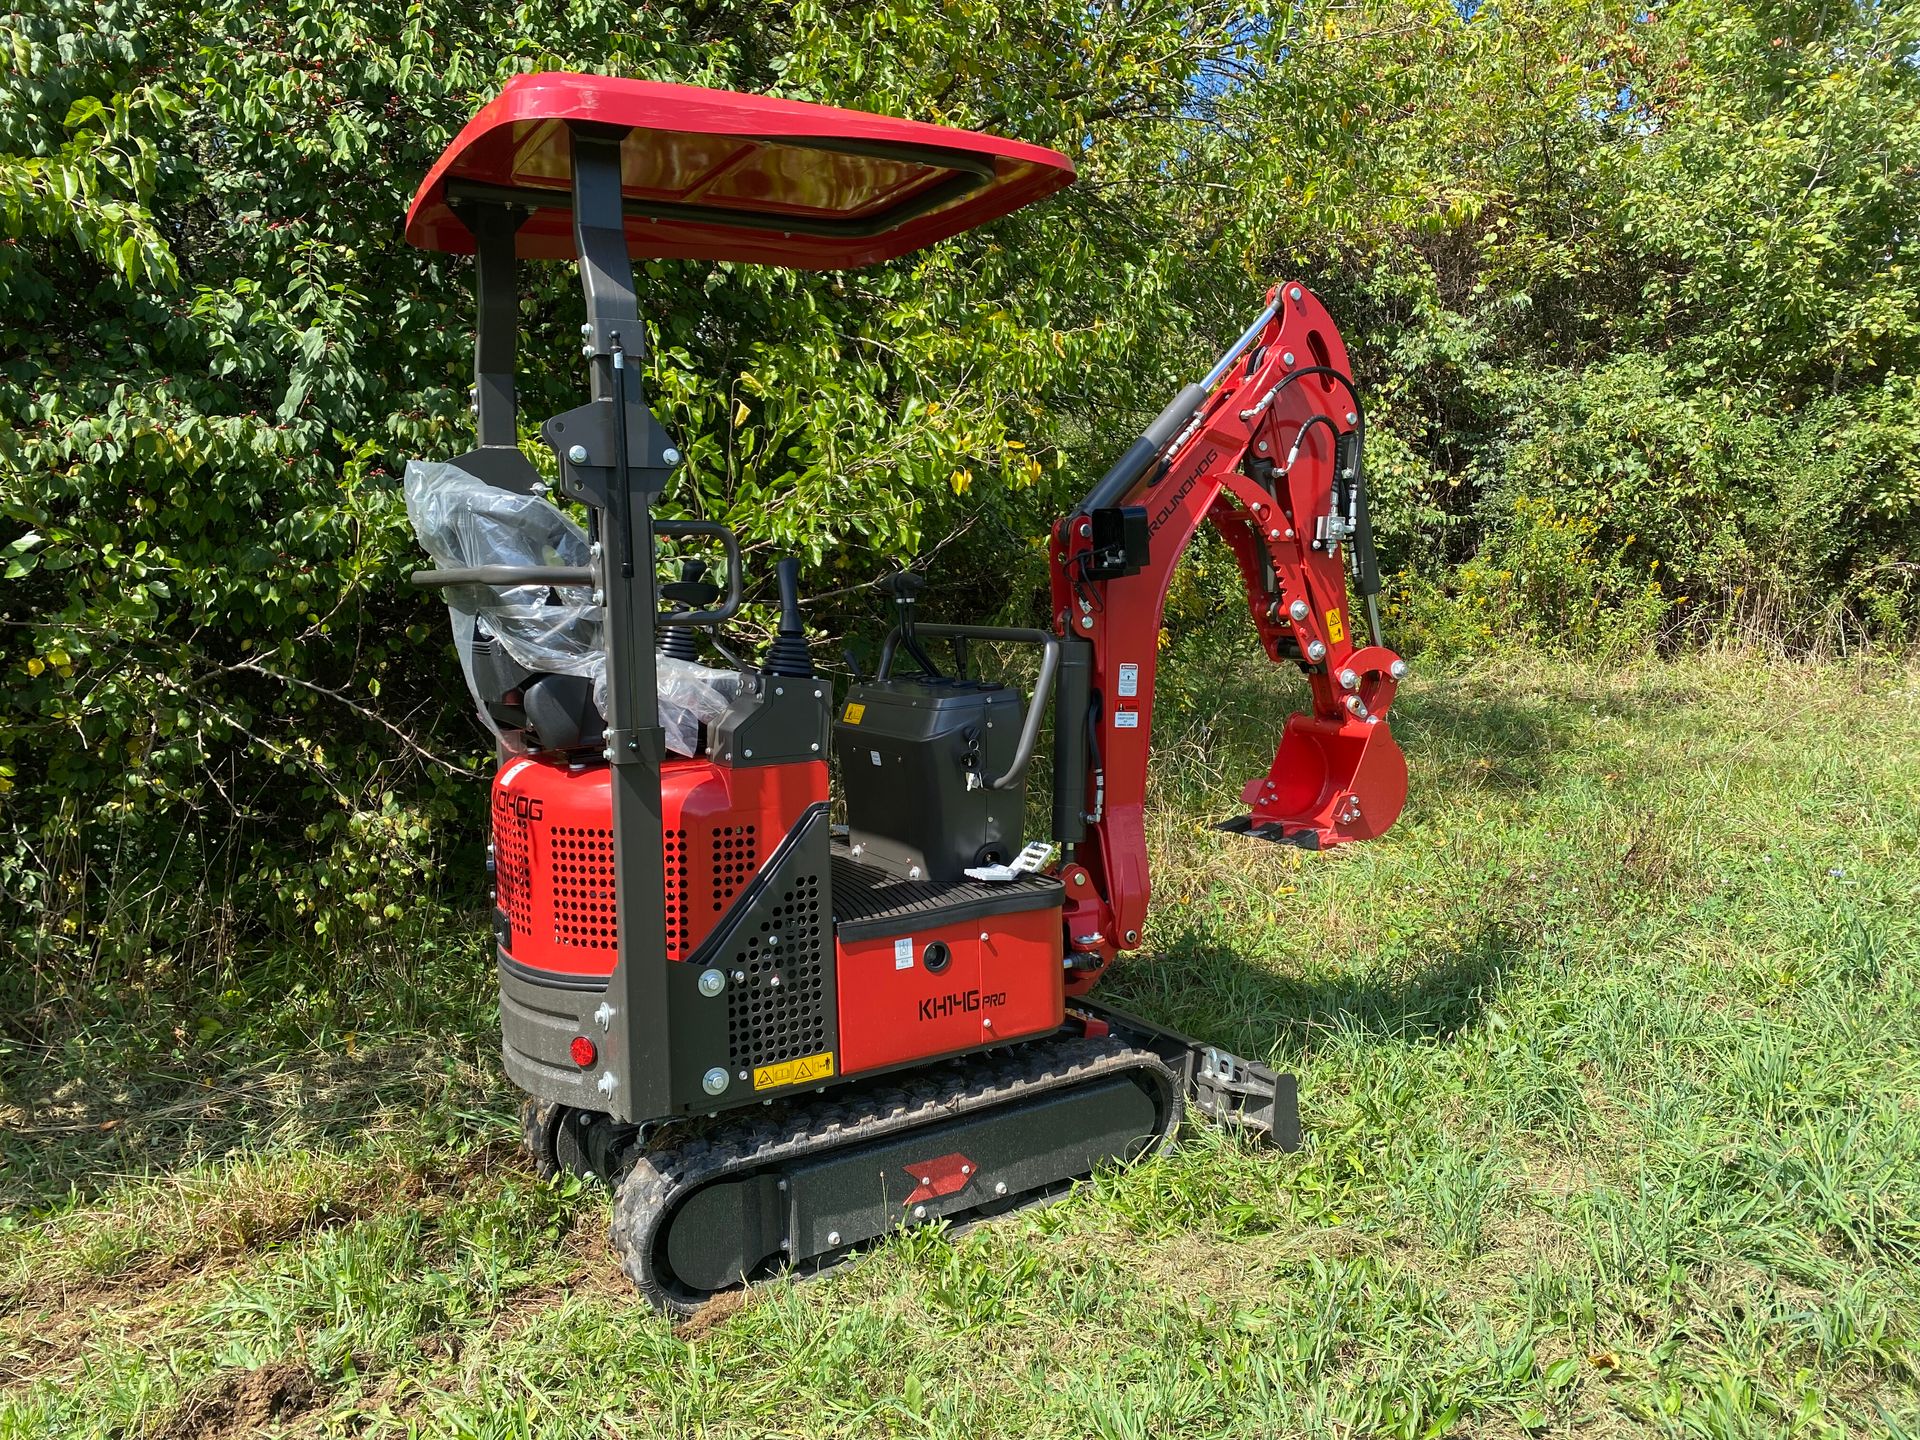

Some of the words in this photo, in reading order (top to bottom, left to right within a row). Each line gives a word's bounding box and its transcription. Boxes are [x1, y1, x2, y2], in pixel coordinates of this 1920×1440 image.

[1147, 448, 1218, 537] ROUNDHOG
[918, 989, 979, 1021] KH14G
[981, 992, 1007, 1010] PRO
